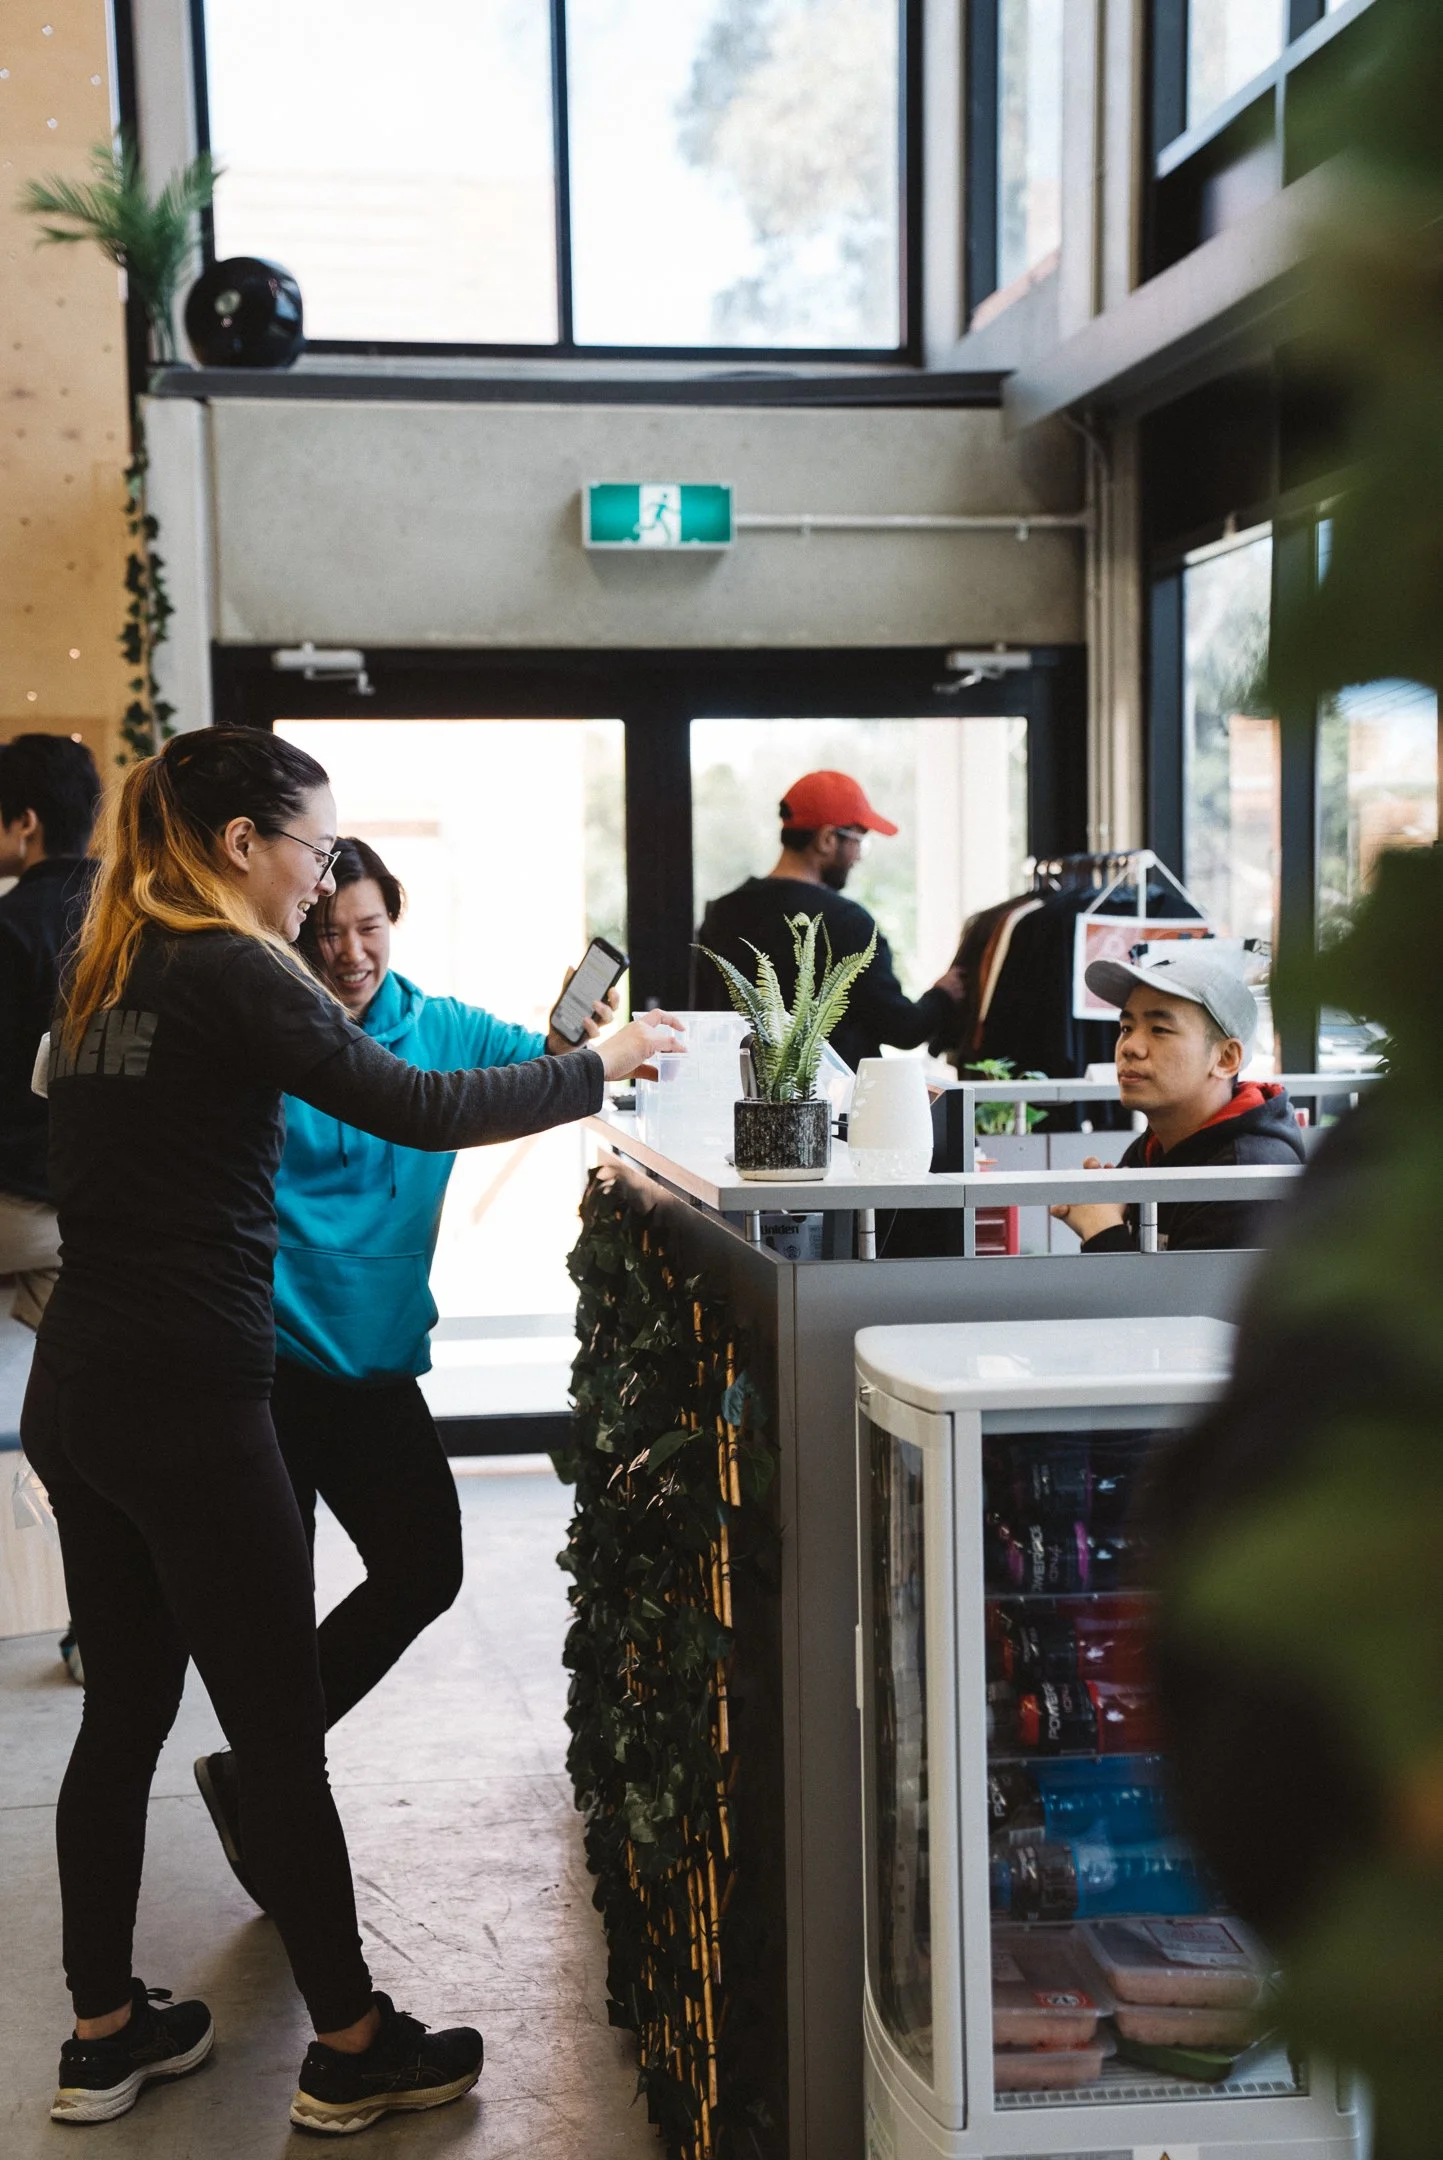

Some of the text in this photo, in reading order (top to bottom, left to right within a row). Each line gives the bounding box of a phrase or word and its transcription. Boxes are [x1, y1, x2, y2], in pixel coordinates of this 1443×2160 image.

[760, 1223, 800, 1235] Uniden
[1028, 1524, 1045, 1593] WERADE
[1041, 1680, 1061, 1741] POWER
